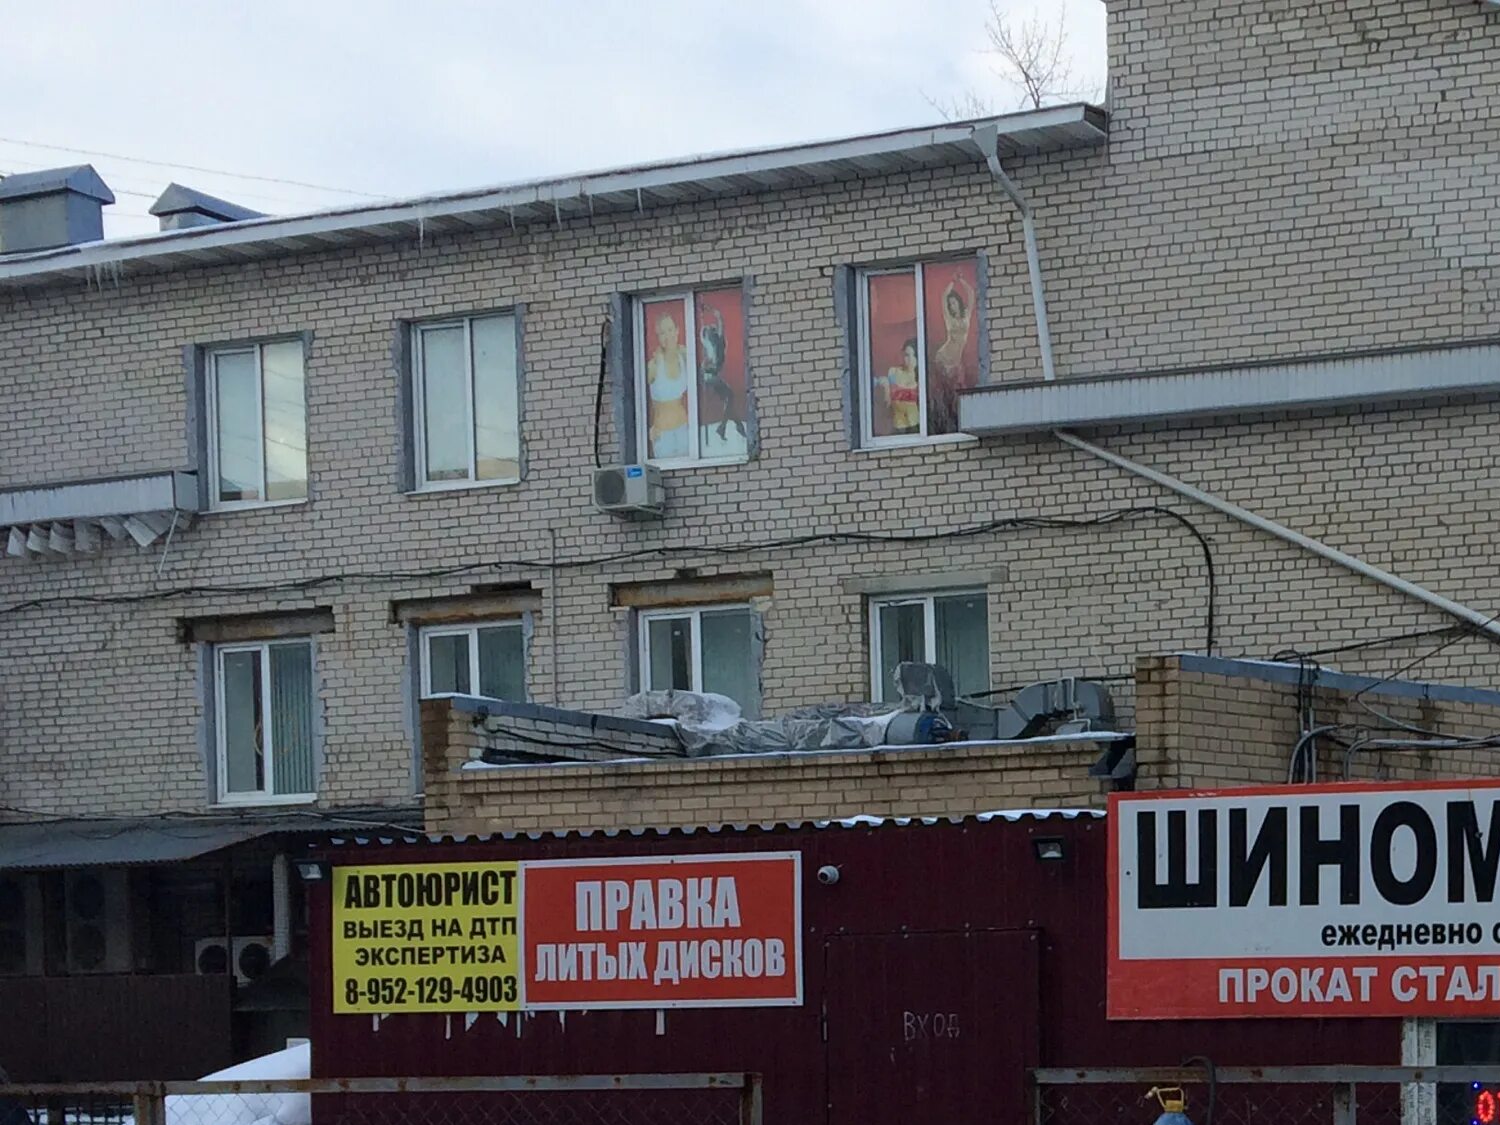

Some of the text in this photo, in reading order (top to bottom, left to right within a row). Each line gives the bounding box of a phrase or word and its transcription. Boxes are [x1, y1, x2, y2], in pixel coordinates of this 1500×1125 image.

[344, 870, 516, 909] АВТОЮРИСТ
[575, 877, 741, 932] ПРАВКА
[344, 916, 516, 941] ВЫЕЗД НА ДТП
[1320, 917, 1483, 950] ежедневно
[355, 945, 506, 967] ЭКСПЕРТИЗА
[535, 938, 786, 986] ЛИТЫХ ДИСКОВ
[345, 976, 517, 1005] 8-952-129-4903
[1218, 966, 1379, 1004] ПРОКАТ
